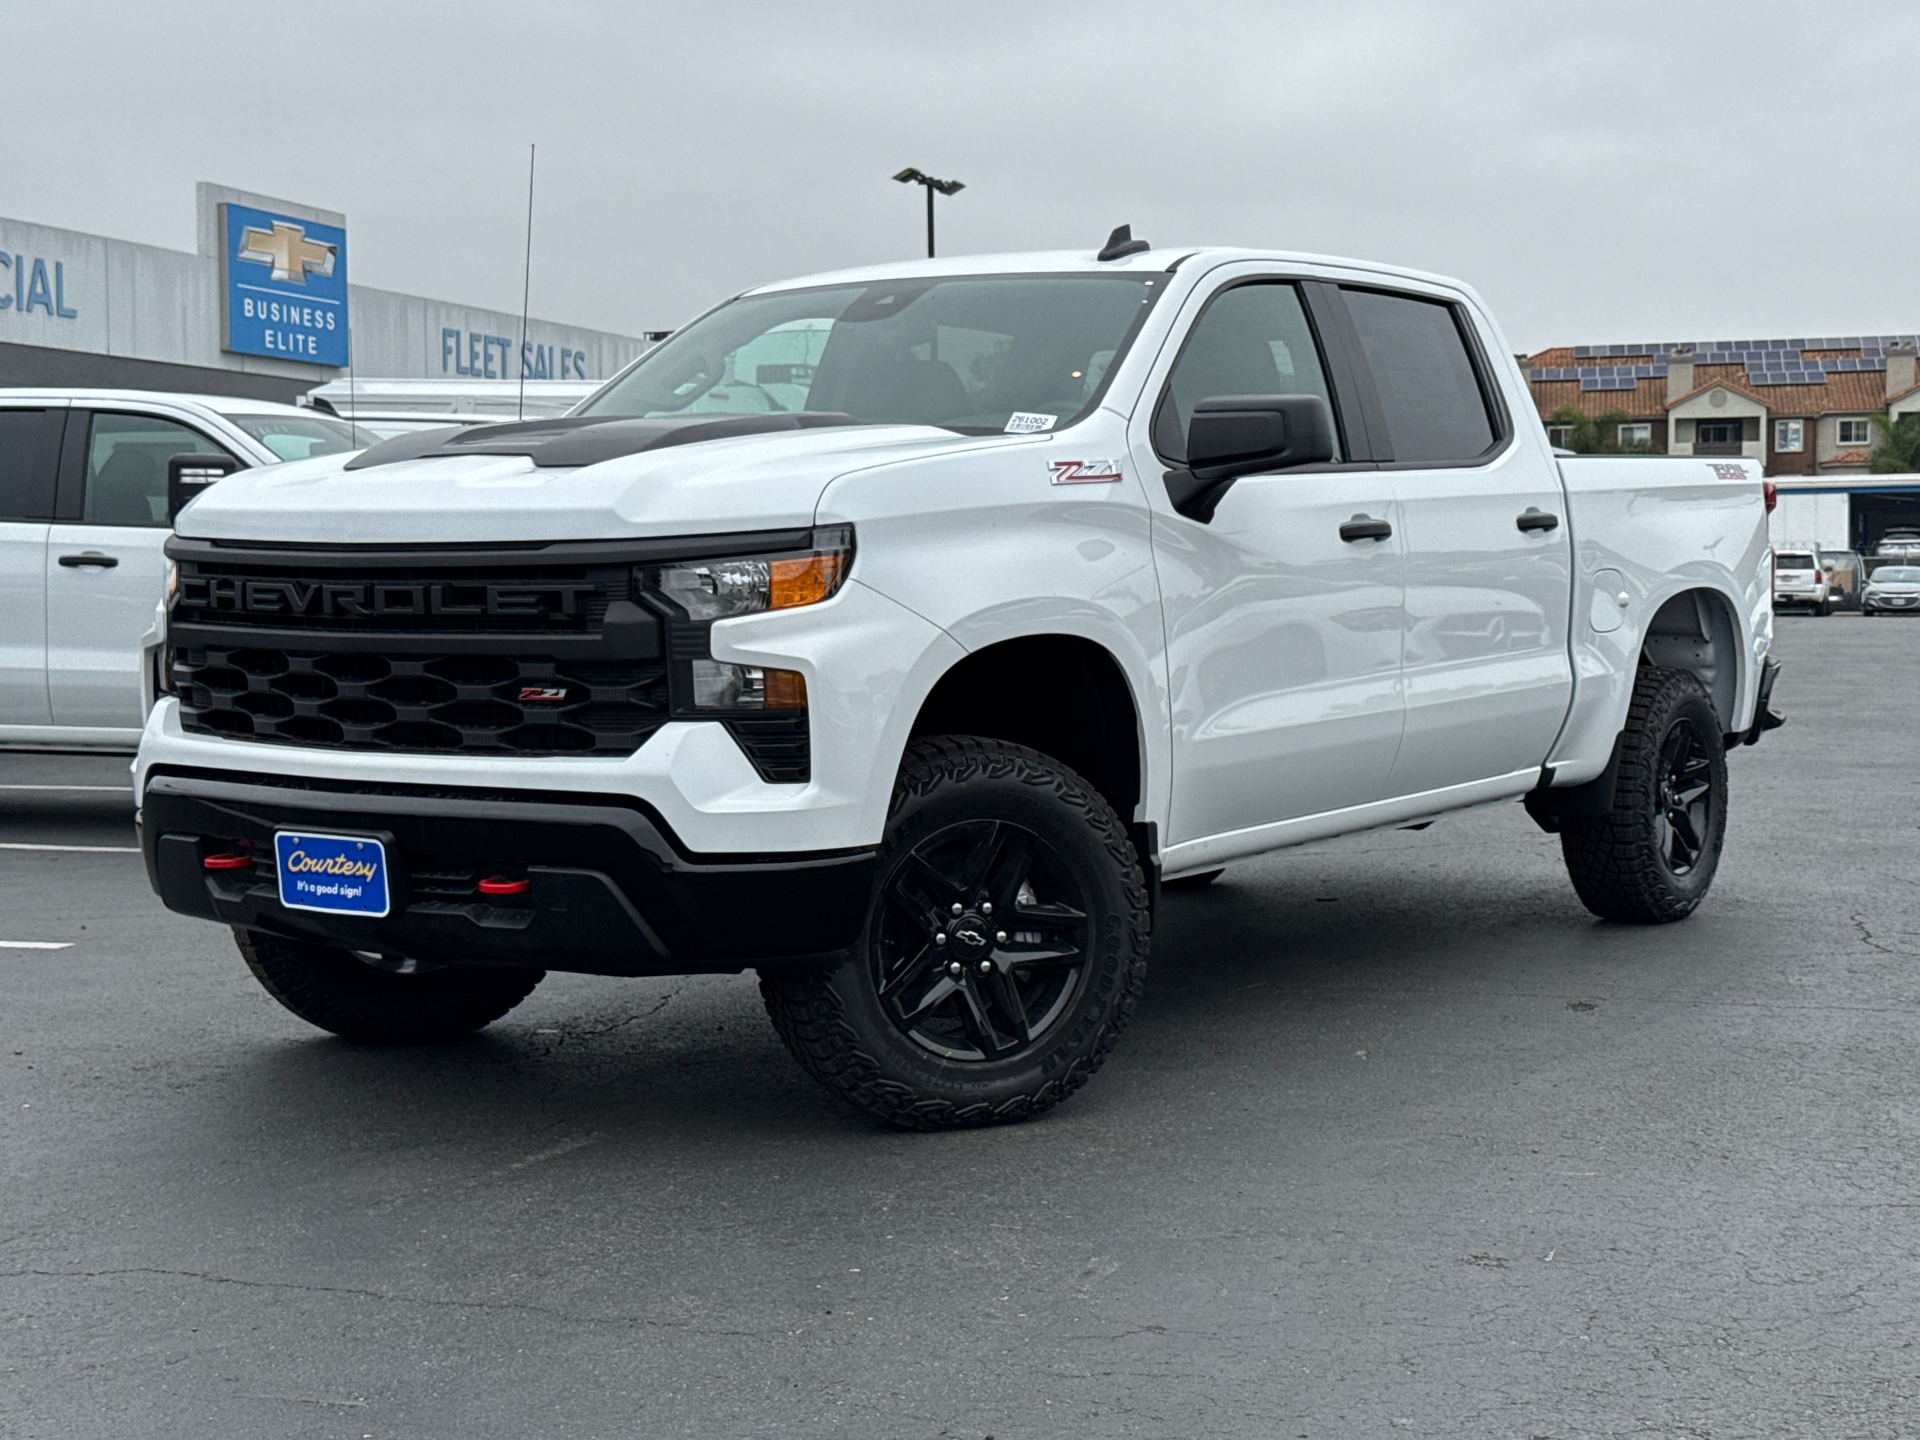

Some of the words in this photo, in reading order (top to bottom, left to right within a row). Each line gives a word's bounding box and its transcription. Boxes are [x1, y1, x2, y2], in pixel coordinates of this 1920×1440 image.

[243, 297, 336, 331] BUSINESS
[264, 329, 318, 355] ELITE
[442, 327, 512, 380] FLEET
[520, 341, 586, 380] SALES
[1047, 460, 1123, 486] Z71
[1705, 463, 1749, 473] TRAIL
[178, 576, 599, 616] CHEVROLET
[287, 850, 378, 883] Courtesy
[297, 880, 309, 892] It's
[310, 884, 316, 893] a
[316, 883, 338, 896] good
[340, 884, 362, 899] sign!
